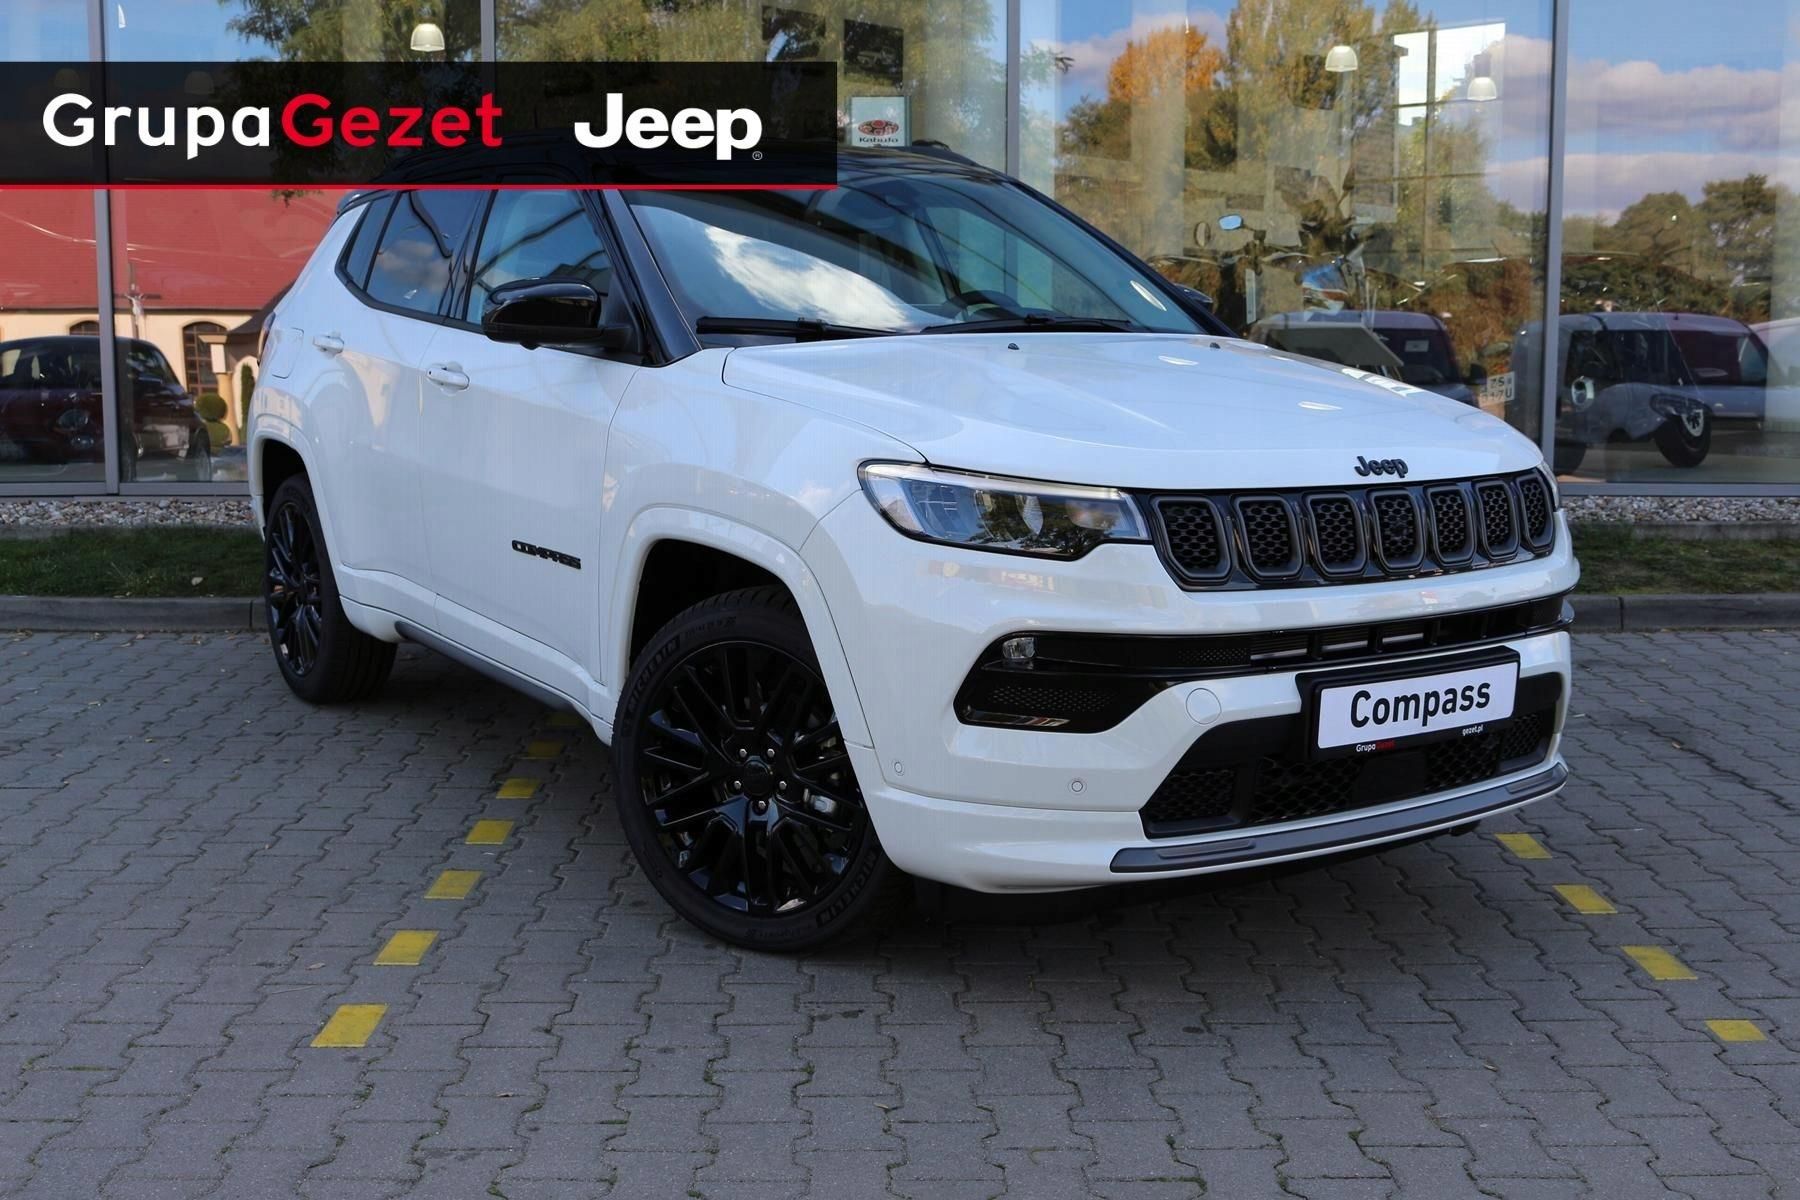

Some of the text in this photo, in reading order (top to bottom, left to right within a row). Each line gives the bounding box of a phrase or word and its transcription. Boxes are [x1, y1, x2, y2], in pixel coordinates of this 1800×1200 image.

[1354, 455, 1408, 478] Jeep
[512, 540, 581, 570] COMPASS
[1351, 682, 1491, 728] Compass
